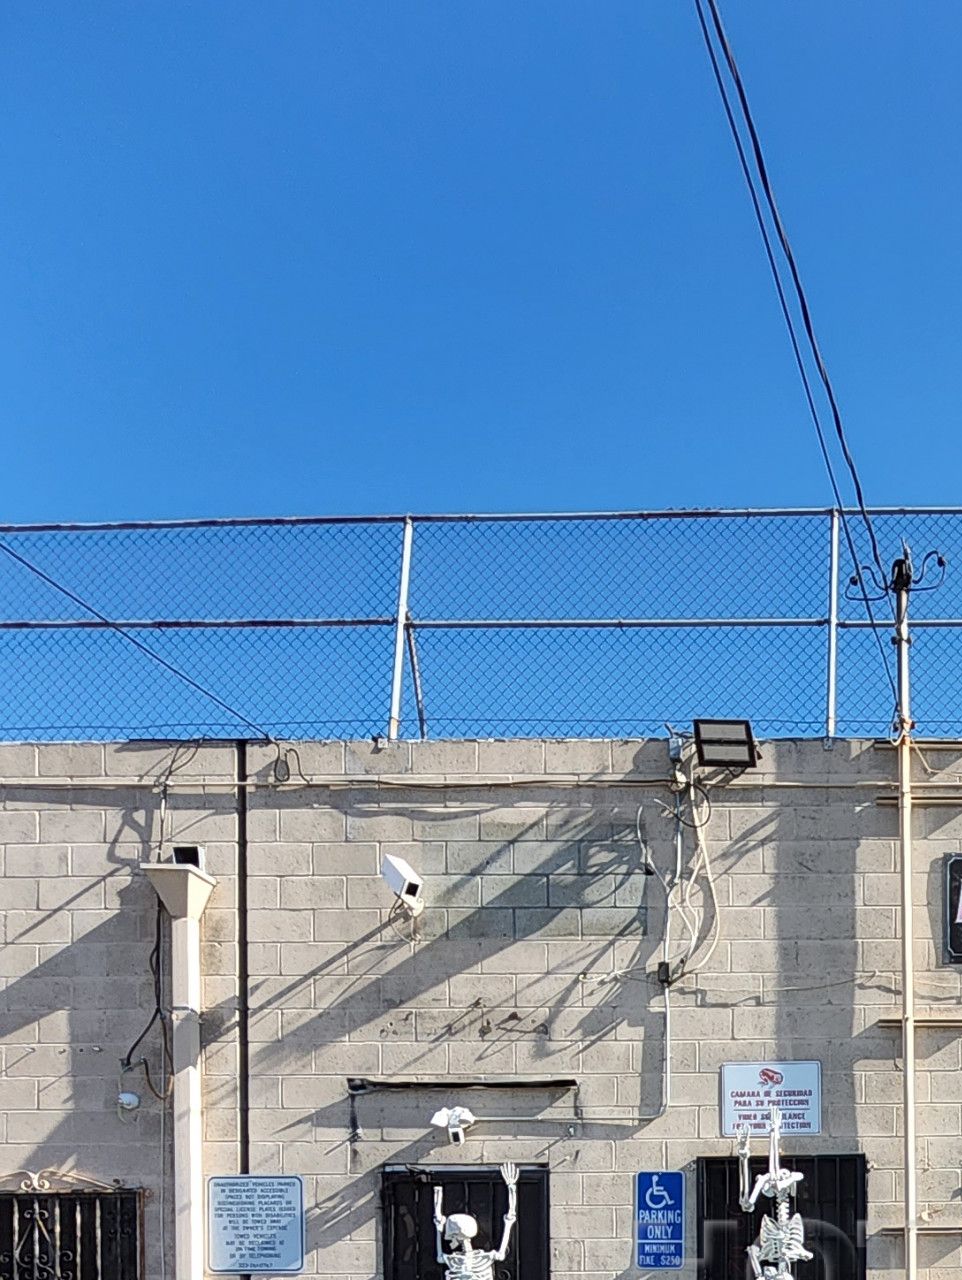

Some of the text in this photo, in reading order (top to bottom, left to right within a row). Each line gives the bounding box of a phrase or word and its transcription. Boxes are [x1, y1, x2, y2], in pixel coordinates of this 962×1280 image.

[639, 1210, 681, 1223] PARKING
[647, 1225, 673, 1239] ONLY
[644, 1244, 675, 1253] MINIMUM
[639, 1256, 655, 1265] FINE
